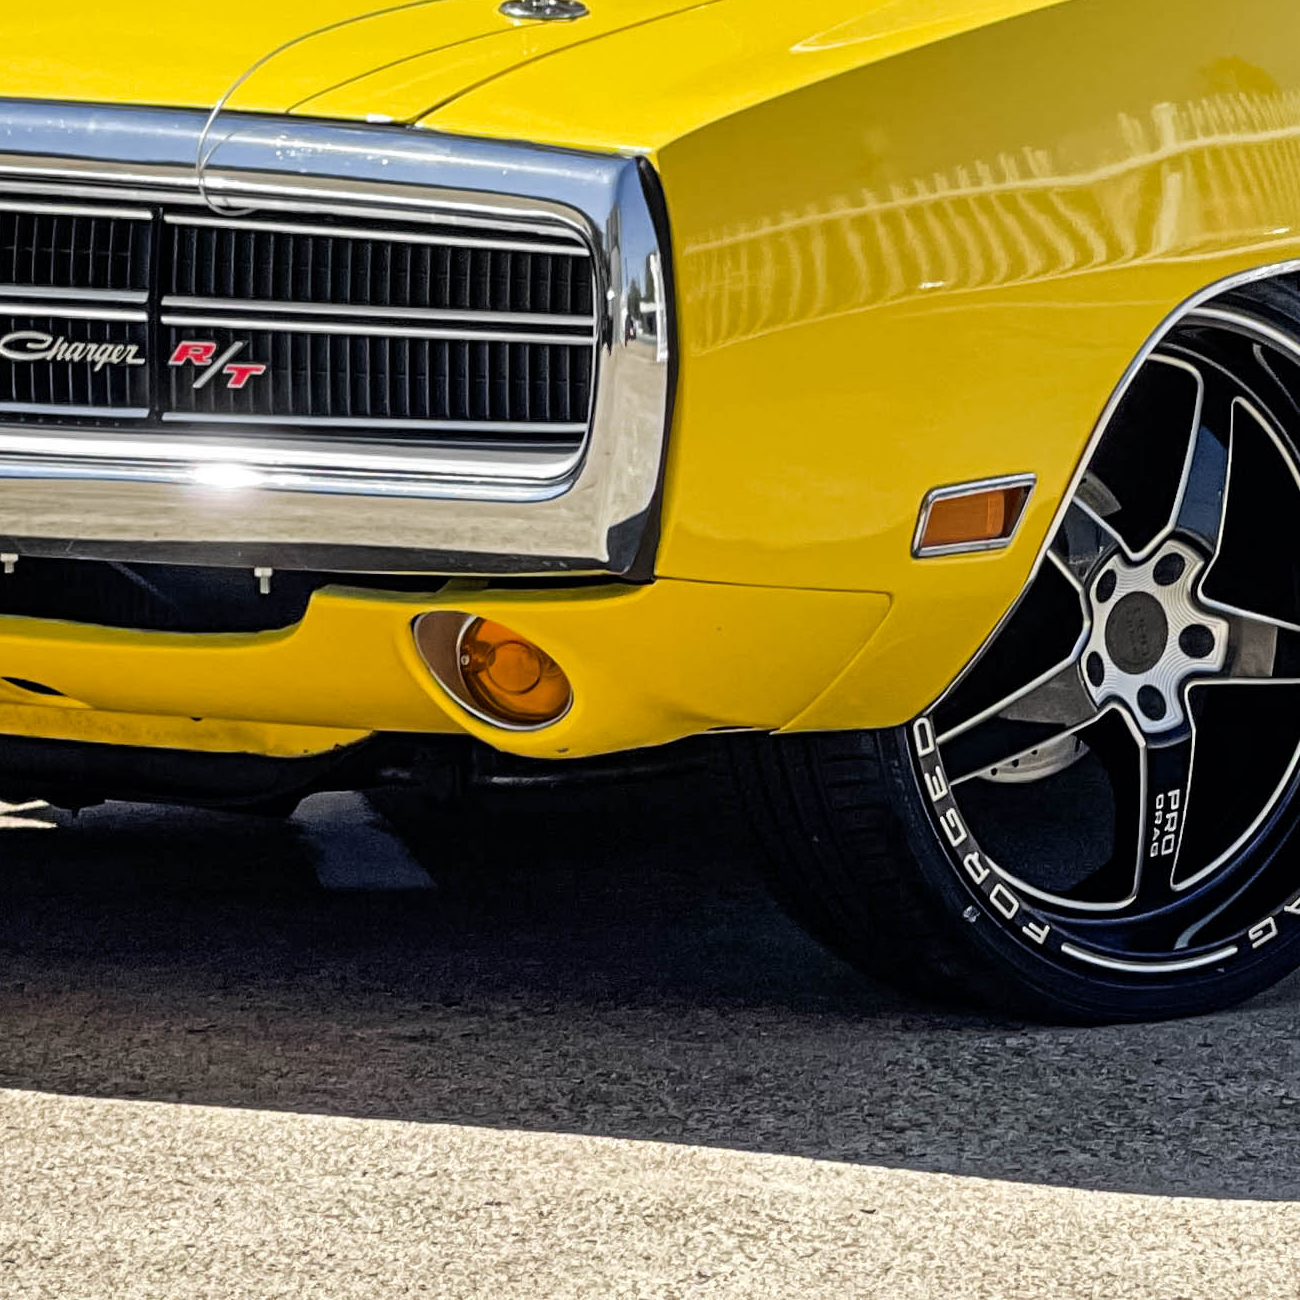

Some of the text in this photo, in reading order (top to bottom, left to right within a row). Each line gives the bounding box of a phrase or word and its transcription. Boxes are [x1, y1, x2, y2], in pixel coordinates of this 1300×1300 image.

[167, 340, 266, 389] R/T
[912, 716, 1051, 945] FORGED
[1150, 793, 1164, 857] DRAG
[1161, 788, 1180, 856] PRO
